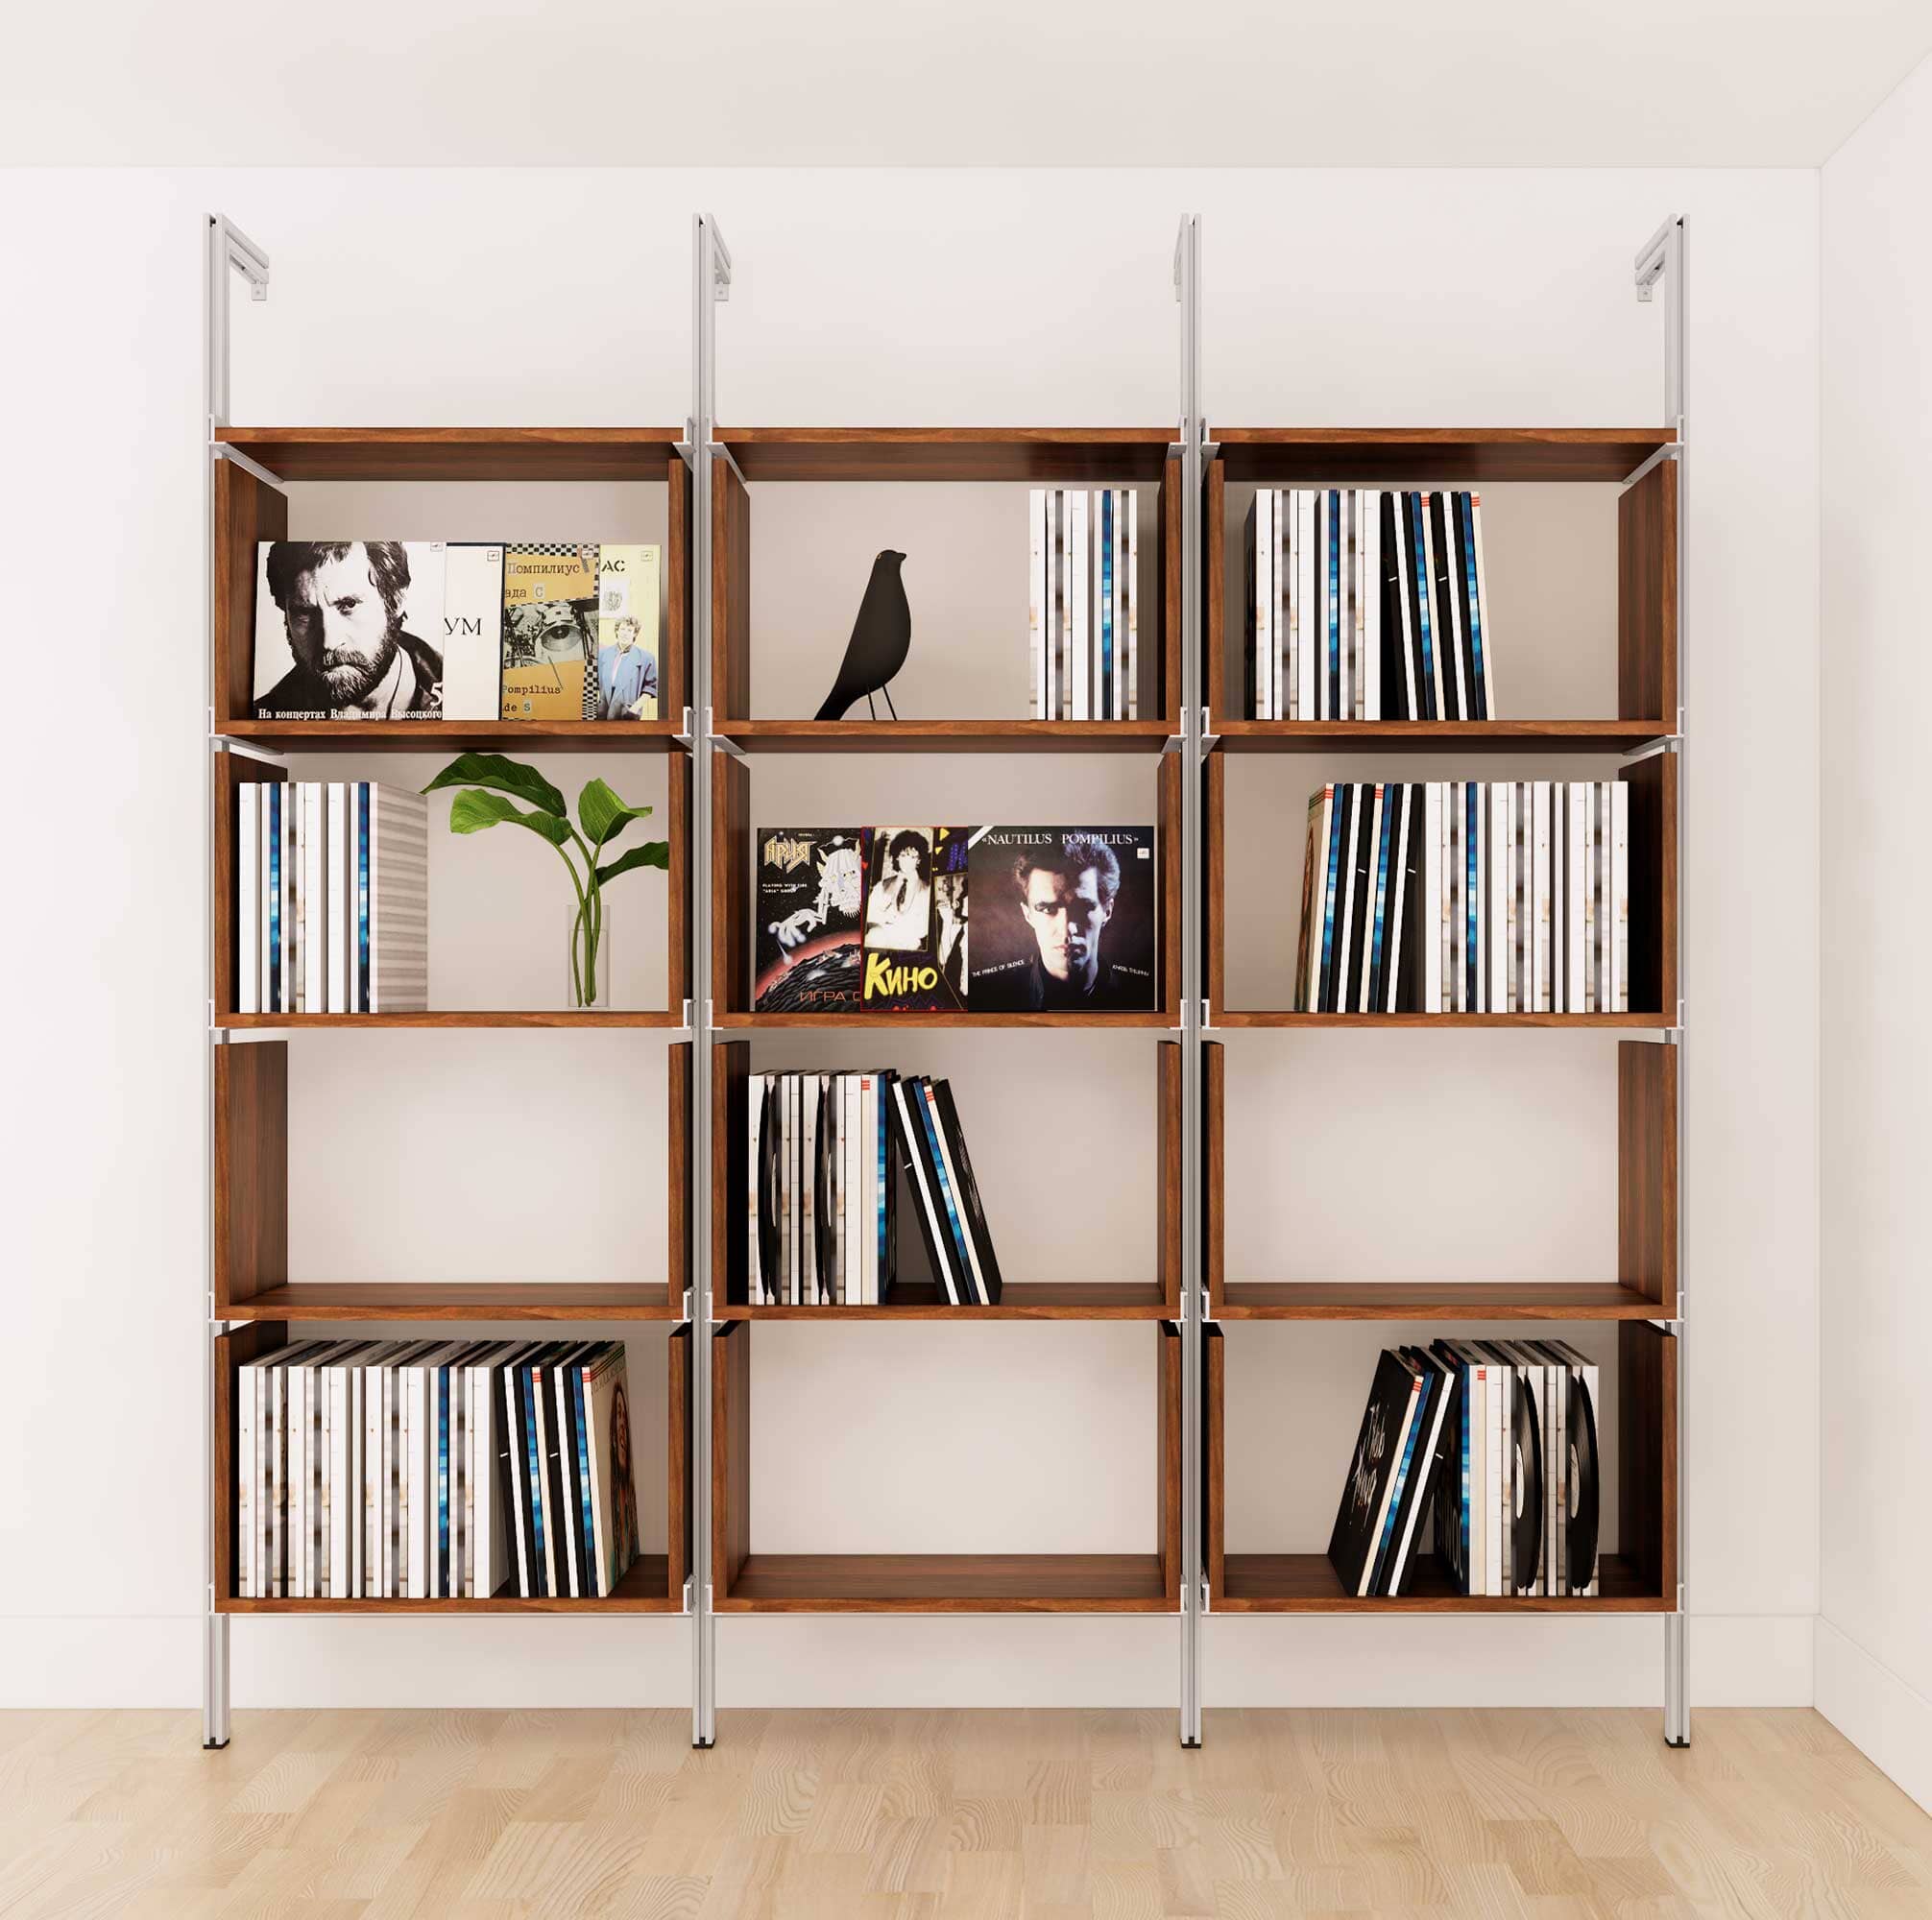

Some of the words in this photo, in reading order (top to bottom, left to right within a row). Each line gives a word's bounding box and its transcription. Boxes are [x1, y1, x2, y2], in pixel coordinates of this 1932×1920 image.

[507, 563, 580, 576] Помпилиус
[444, 617, 482, 636] УМ
[429, 682, 443, 707] 5
[258, 708, 272, 719] На
[275, 709, 326, 720] концертах
[330, 708, 386, 720] Владимира
[391, 708, 443, 720] Высоцкого
[800, 991, 846, 1003] ИГРА
